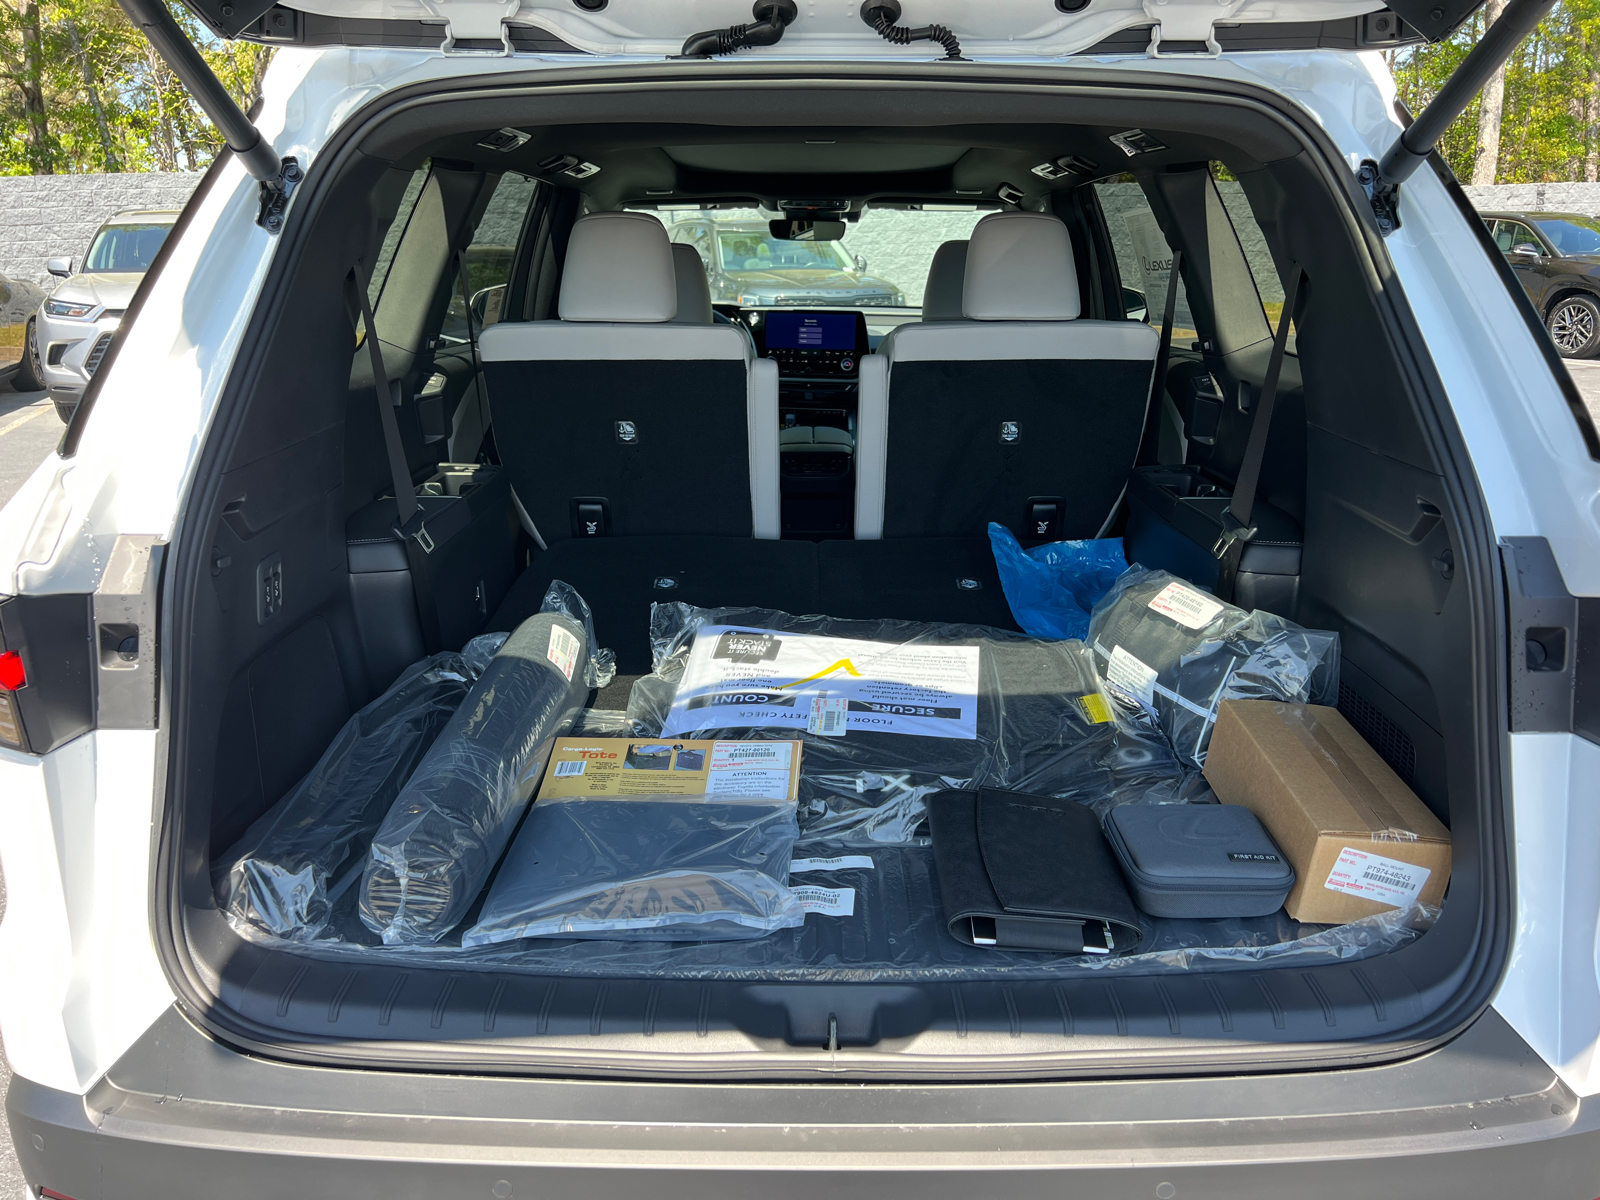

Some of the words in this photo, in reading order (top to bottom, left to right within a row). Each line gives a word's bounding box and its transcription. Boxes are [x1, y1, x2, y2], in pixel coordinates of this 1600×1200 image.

[728, 643, 767, 652] NEVER
[739, 639, 772, 648] STACK
[1122, 655, 1145, 672] ATTENTION
[712, 694, 769, 704] COUNT
[872, 704, 936, 715] SECURE
[738, 711, 779, 720] CHECK
[780, 712, 808, 720] FETY
[853, 718, 893, 726] FLOOR
[578, 750, 619, 759] Tote
[1366, 864, 1412, 882] PT974-48243
